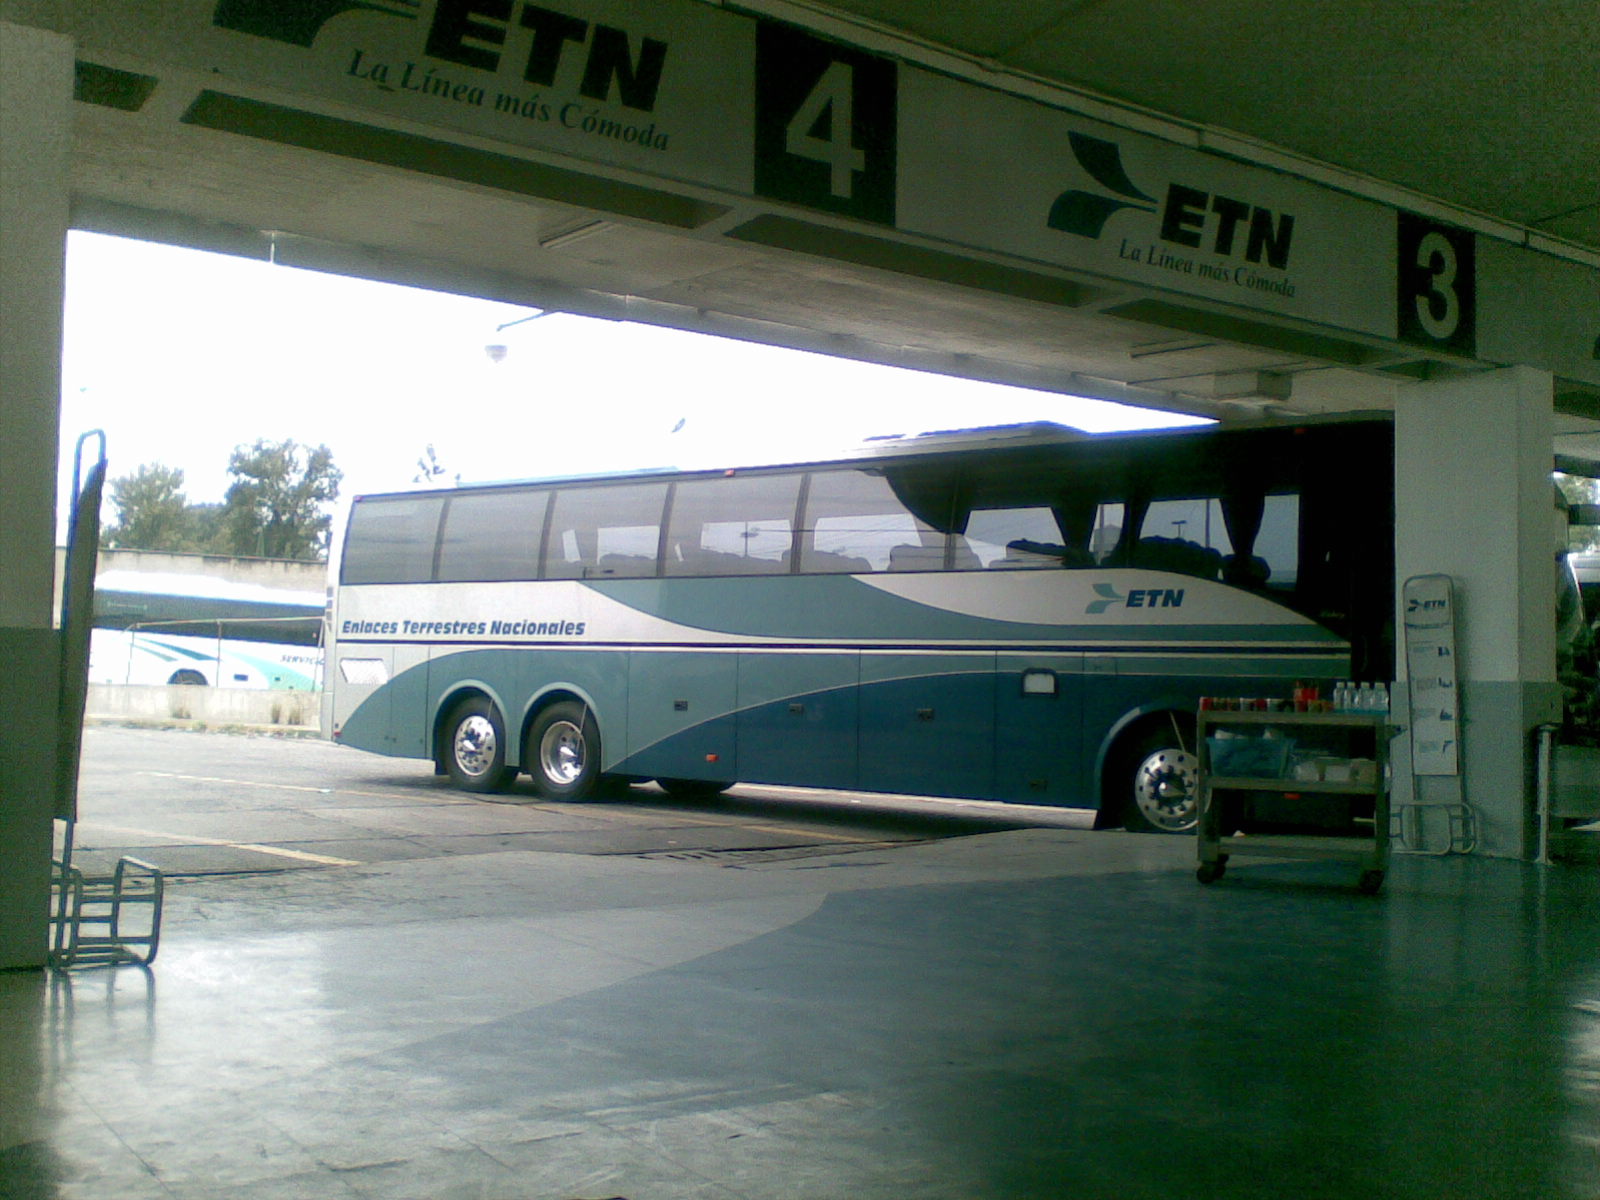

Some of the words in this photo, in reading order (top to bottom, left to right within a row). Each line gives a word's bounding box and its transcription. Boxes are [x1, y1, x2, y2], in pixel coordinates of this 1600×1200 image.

[346, 48, 389, 84] La
[401, 60, 485, 107] Línea
[495, 90, 550, 123] más
[559, 102, 670, 152] Cómoda
[424, 0, 669, 113] ETN
[786, 60, 866, 199] 4
[1119, 239, 1141, 262] La
[1146, 246, 1193, 274] Línea
[1199, 262, 1230, 284] más
[1234, 266, 1297, 298] Cómoda
[1160, 183, 1296, 271] ETN
[1416, 231, 1460, 339] 3
[342, 620, 399, 635] Enlaces
[402, 620, 487, 636] Terrestres
[490, 620, 586, 637] Nacionales
[1126, 589, 1185, 608] ETN
[1424, 600, 1447, 609] ETN
